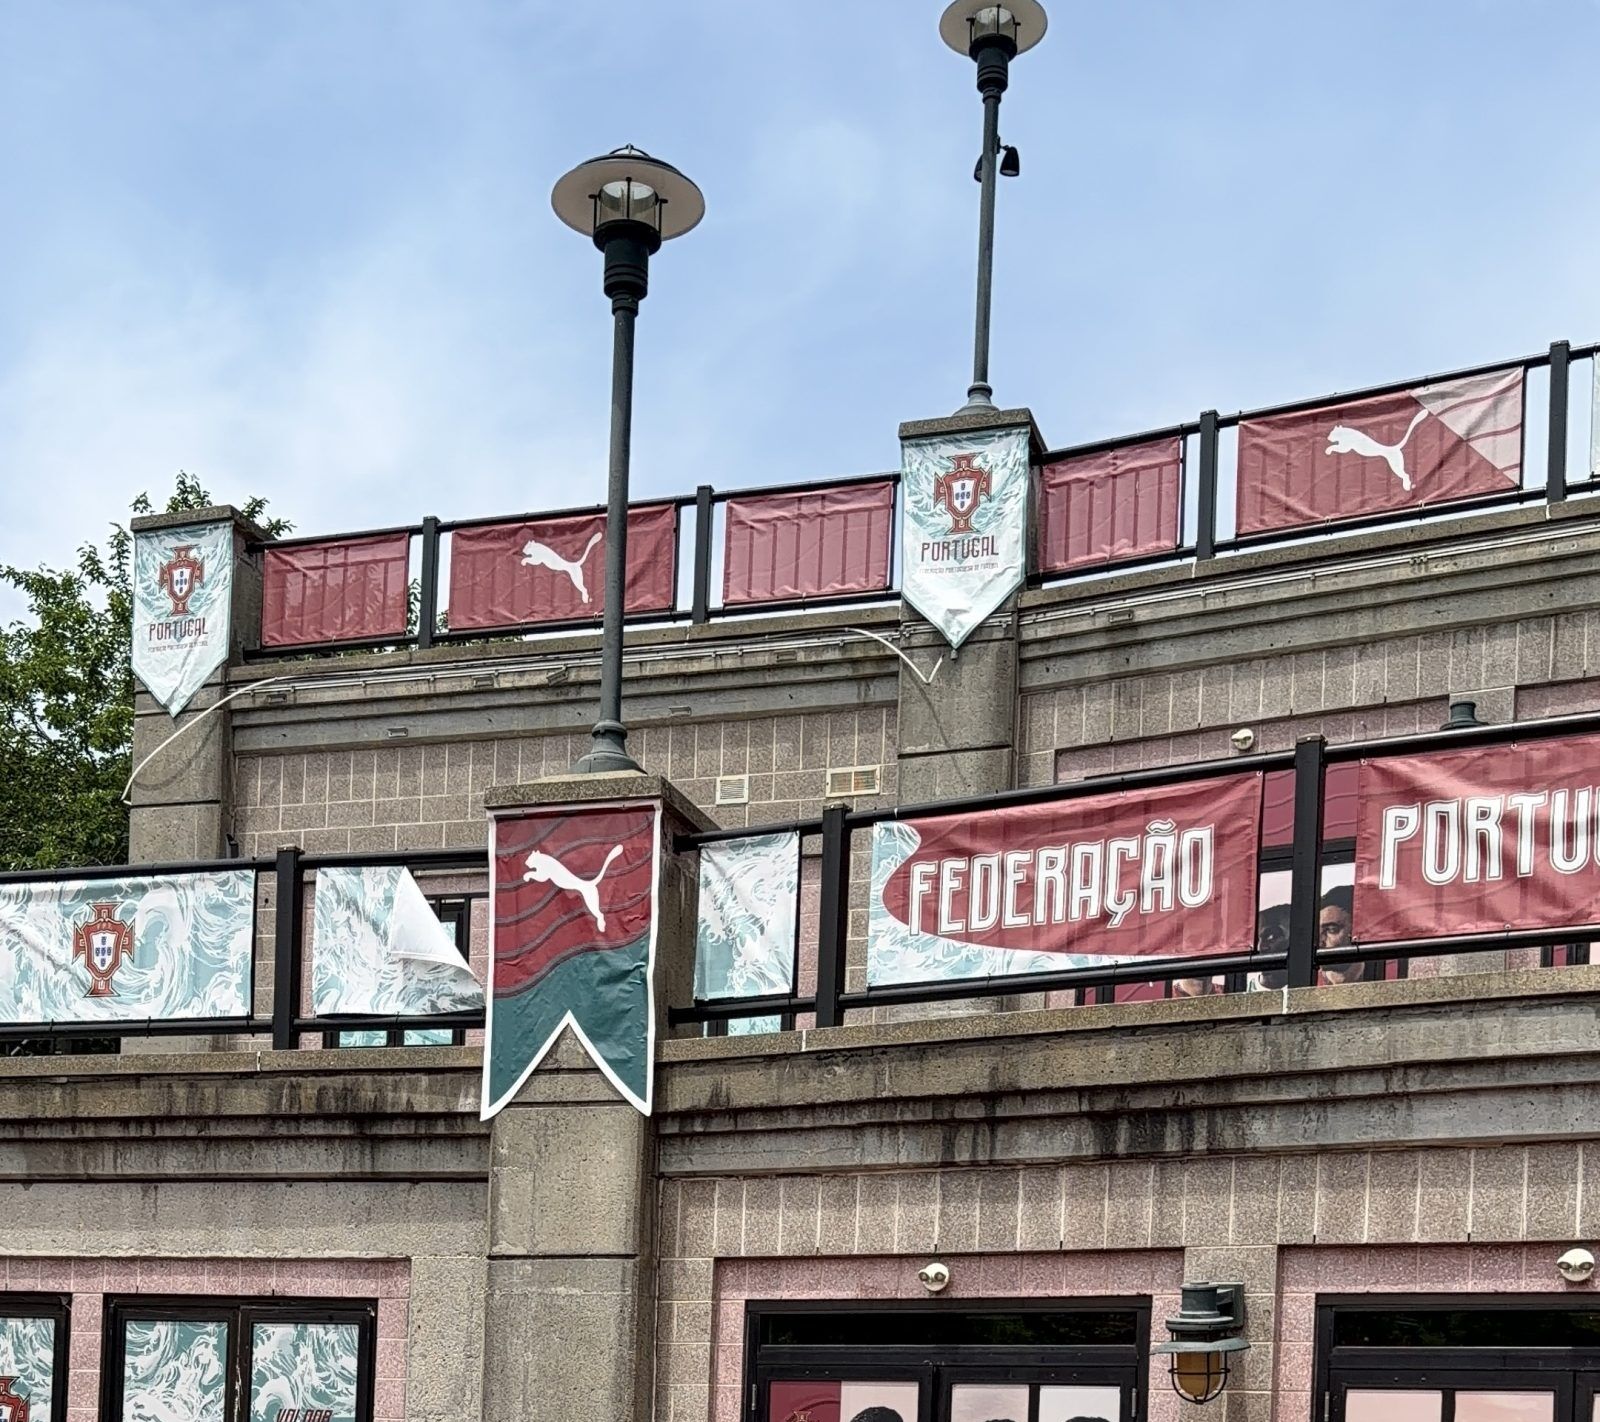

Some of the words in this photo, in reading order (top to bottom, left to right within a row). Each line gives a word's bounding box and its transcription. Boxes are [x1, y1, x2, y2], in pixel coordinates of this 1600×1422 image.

[921, 535, 999, 562] PORTUGAL
[149, 617, 208, 641] PORTUGAL
[1379, 785, 1600, 889] PORTU
[909, 818, 1214, 936] FEDERAÇÃO
